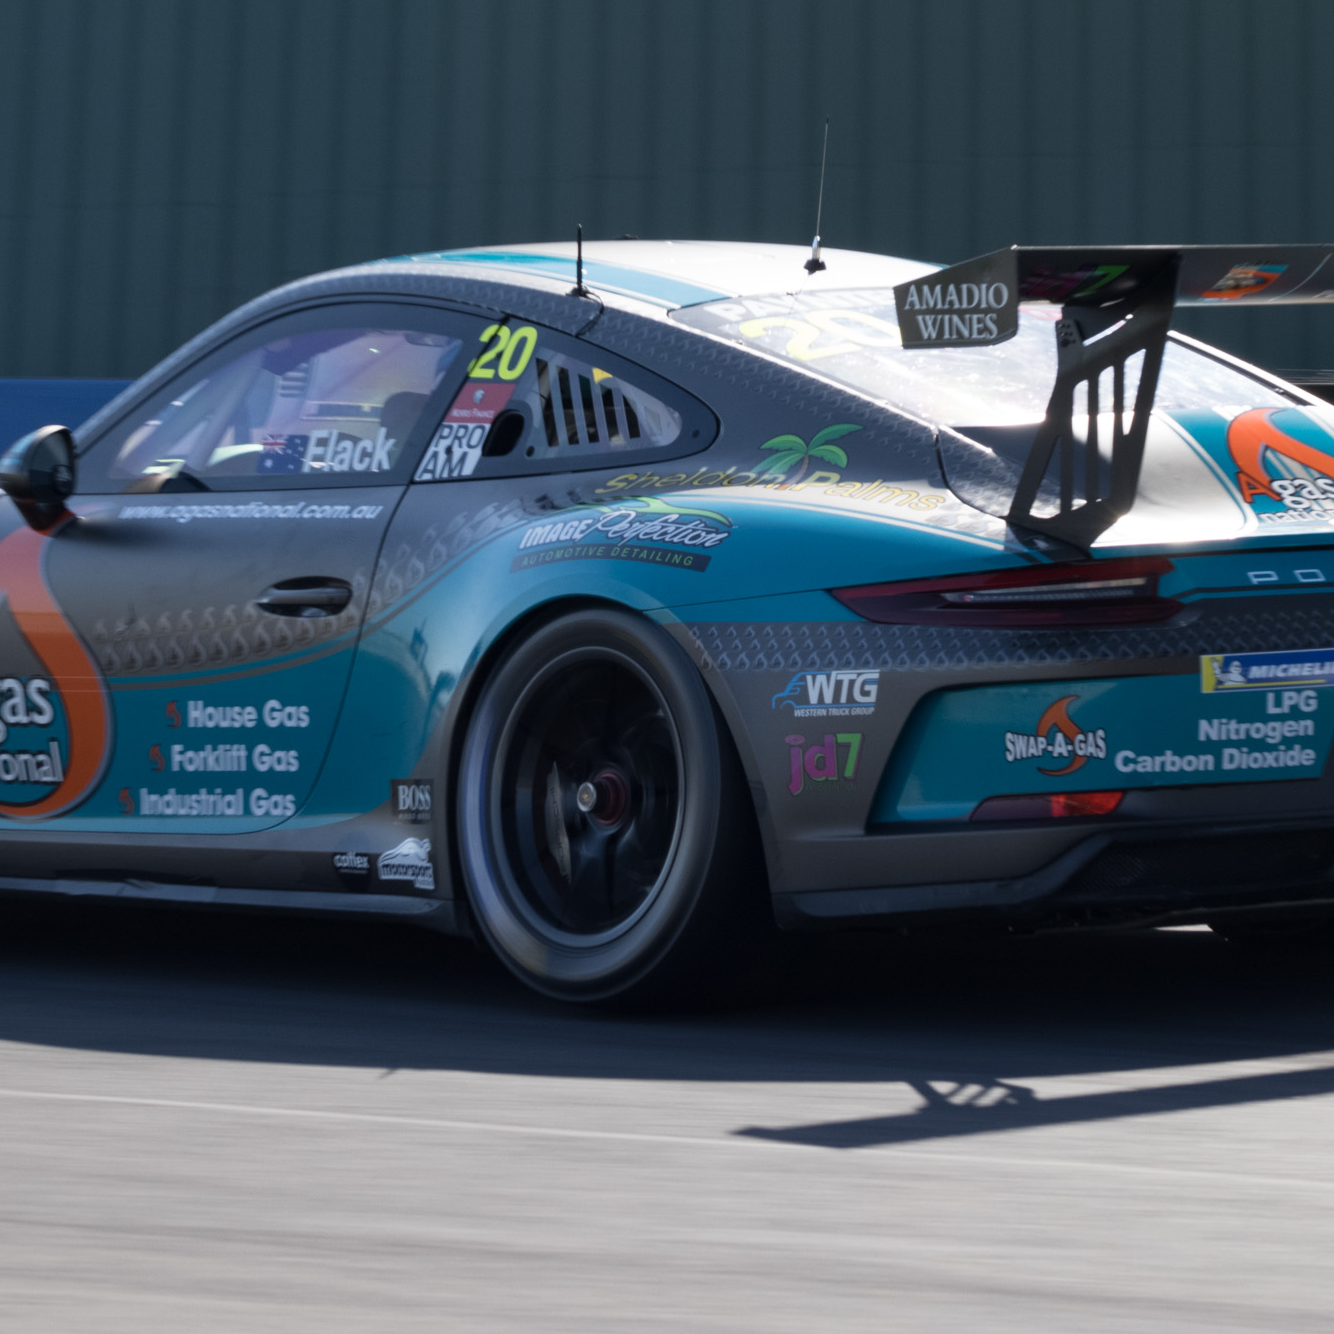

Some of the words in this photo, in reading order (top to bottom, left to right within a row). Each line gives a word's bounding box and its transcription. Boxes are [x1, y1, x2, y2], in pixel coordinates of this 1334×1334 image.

[903, 282, 1009, 310] AMADIO
[738, 309, 902, 361] 20
[916, 313, 999, 340] WINES
[467, 324, 537, 380] 20
[301, 426, 397, 473] Flack
[435, 424, 486, 450] PRO
[418, 450, 469, 479] AM
[595, 466, 780, 494] Sheldon
[794, 470, 947, 511] Palms
[118, 501, 384, 523] www.agasnational.com.au
[519, 519, 592, 550] IMAGE
[585, 510, 732, 548] Perfection
[522, 546, 606, 566] AUTOMOTIVE
[610, 545, 694, 568] DETAILING
[806, 669, 880, 704] WTG
[187, 700, 258, 728] House
[263, 699, 311, 728] Gas
[794, 707, 828, 718] WESTERN
[828, 707, 851, 717] TRUCK
[851, 706, 876, 716] GROUP
[1266, 690, 1319, 715] LPG
[1198, 716, 1315, 744] Nitrogen
[171, 743, 248, 772] Forklift
[252, 742, 300, 772] Gas
[1005, 728, 1107, 762] SWAP-A-GAS
[1114, 748, 1215, 774] Carbon
[1221, 743, 1317, 770] Dioxide
[785, 733, 865, 796] jd7
[139, 787, 244, 816] Industrial
[249, 787, 297, 817] Gas
[397, 784, 432, 811] BOSS
